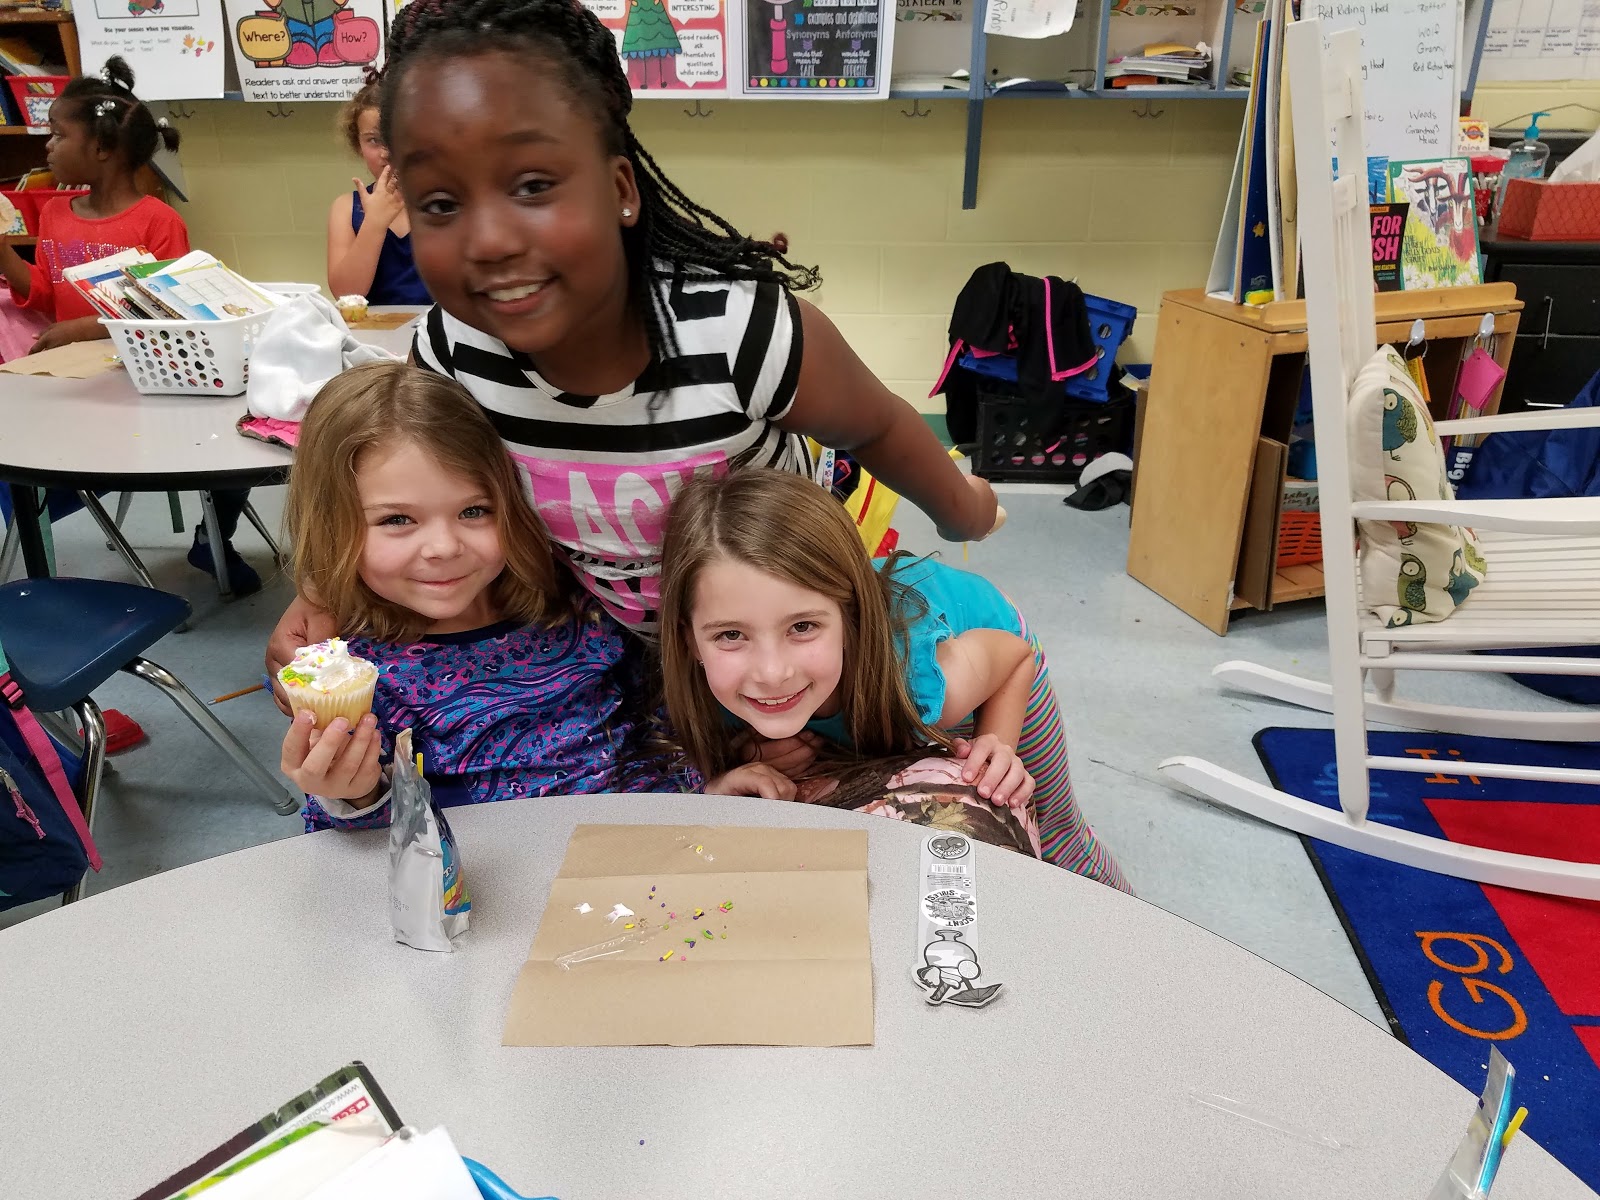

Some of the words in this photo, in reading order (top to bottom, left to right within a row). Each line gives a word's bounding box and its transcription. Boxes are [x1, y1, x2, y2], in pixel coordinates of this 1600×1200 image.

[835, 11, 847, 25] and
[1318, 4, 1334, 20] Red
[1337, 4, 1367, 26] Riding
[1370, 3, 1389, 14] Hood
[242, 31, 286, 42] Where?
[341, 31, 368, 43] How?
[786, 29, 830, 40] Synonyms
[835, 29, 878, 40] Antonyms
[1370, 58, 1385, 70] Hood
[244, 78, 281, 86] Readers
[282, 77, 296, 86] ask
[297, 77, 311, 86] and
[312, 77, 340, 86] answer
[252, 91, 269, 99] text
[270, 91, 278, 99] to
[279, 91, 302, 99] better
[304, 90, 344, 99] understand
[1371, 215, 1403, 236] FOR
[1447, 451, 1473, 481] Big
[945, 915, 975, 927] SCENT
[1415, 930, 1528, 1041] Gg
